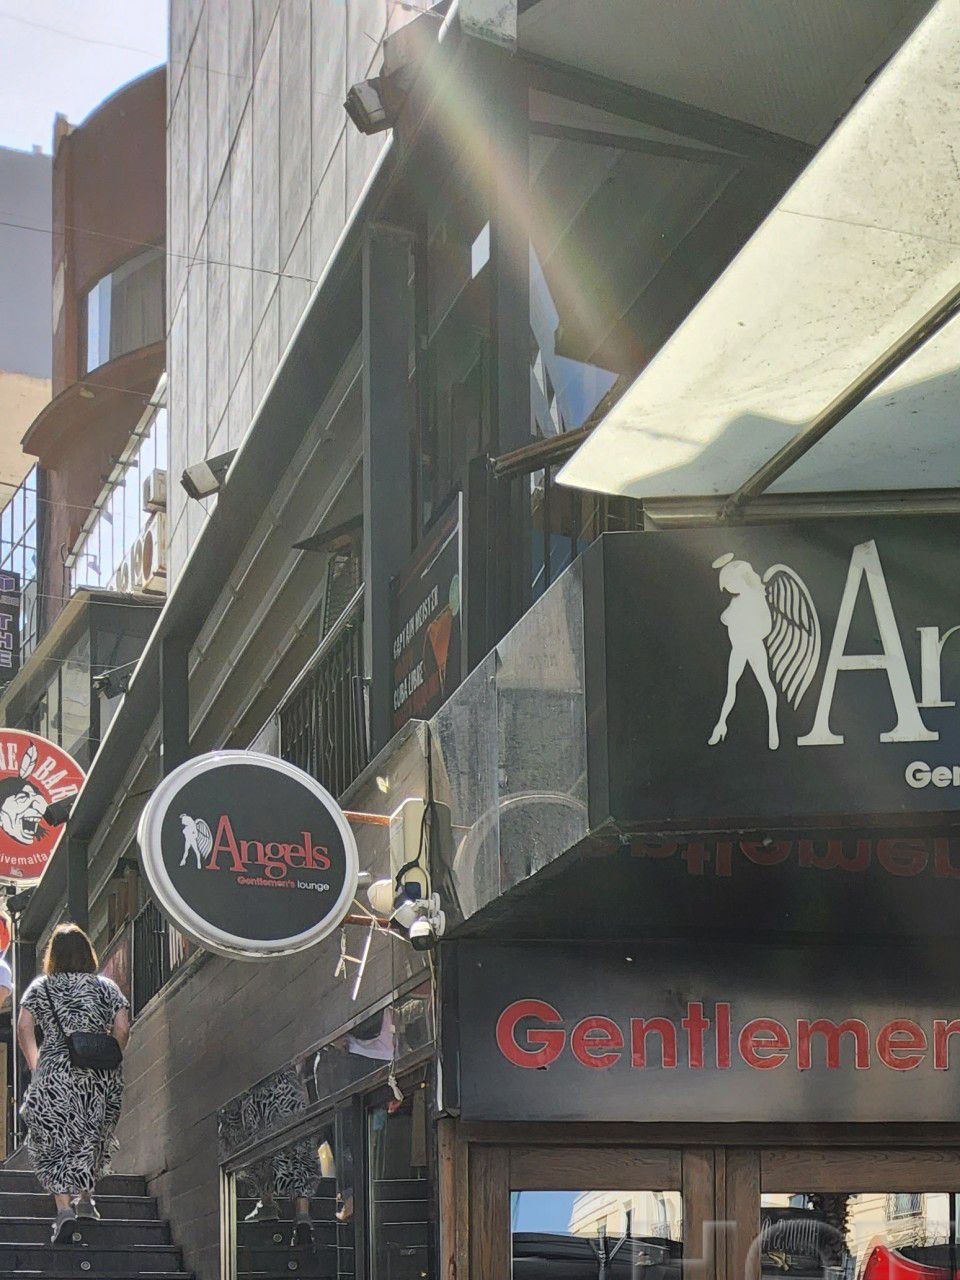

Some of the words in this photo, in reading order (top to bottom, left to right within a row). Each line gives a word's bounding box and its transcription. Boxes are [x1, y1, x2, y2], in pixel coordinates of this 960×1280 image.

[32, 755, 79, 803] BAR
[0, 852, 49, 865] ivemalta
[205, 814, 331, 880] Angels
[236, 876, 295, 889] Gentlemen's
[297, 880, 330, 892] lounge
